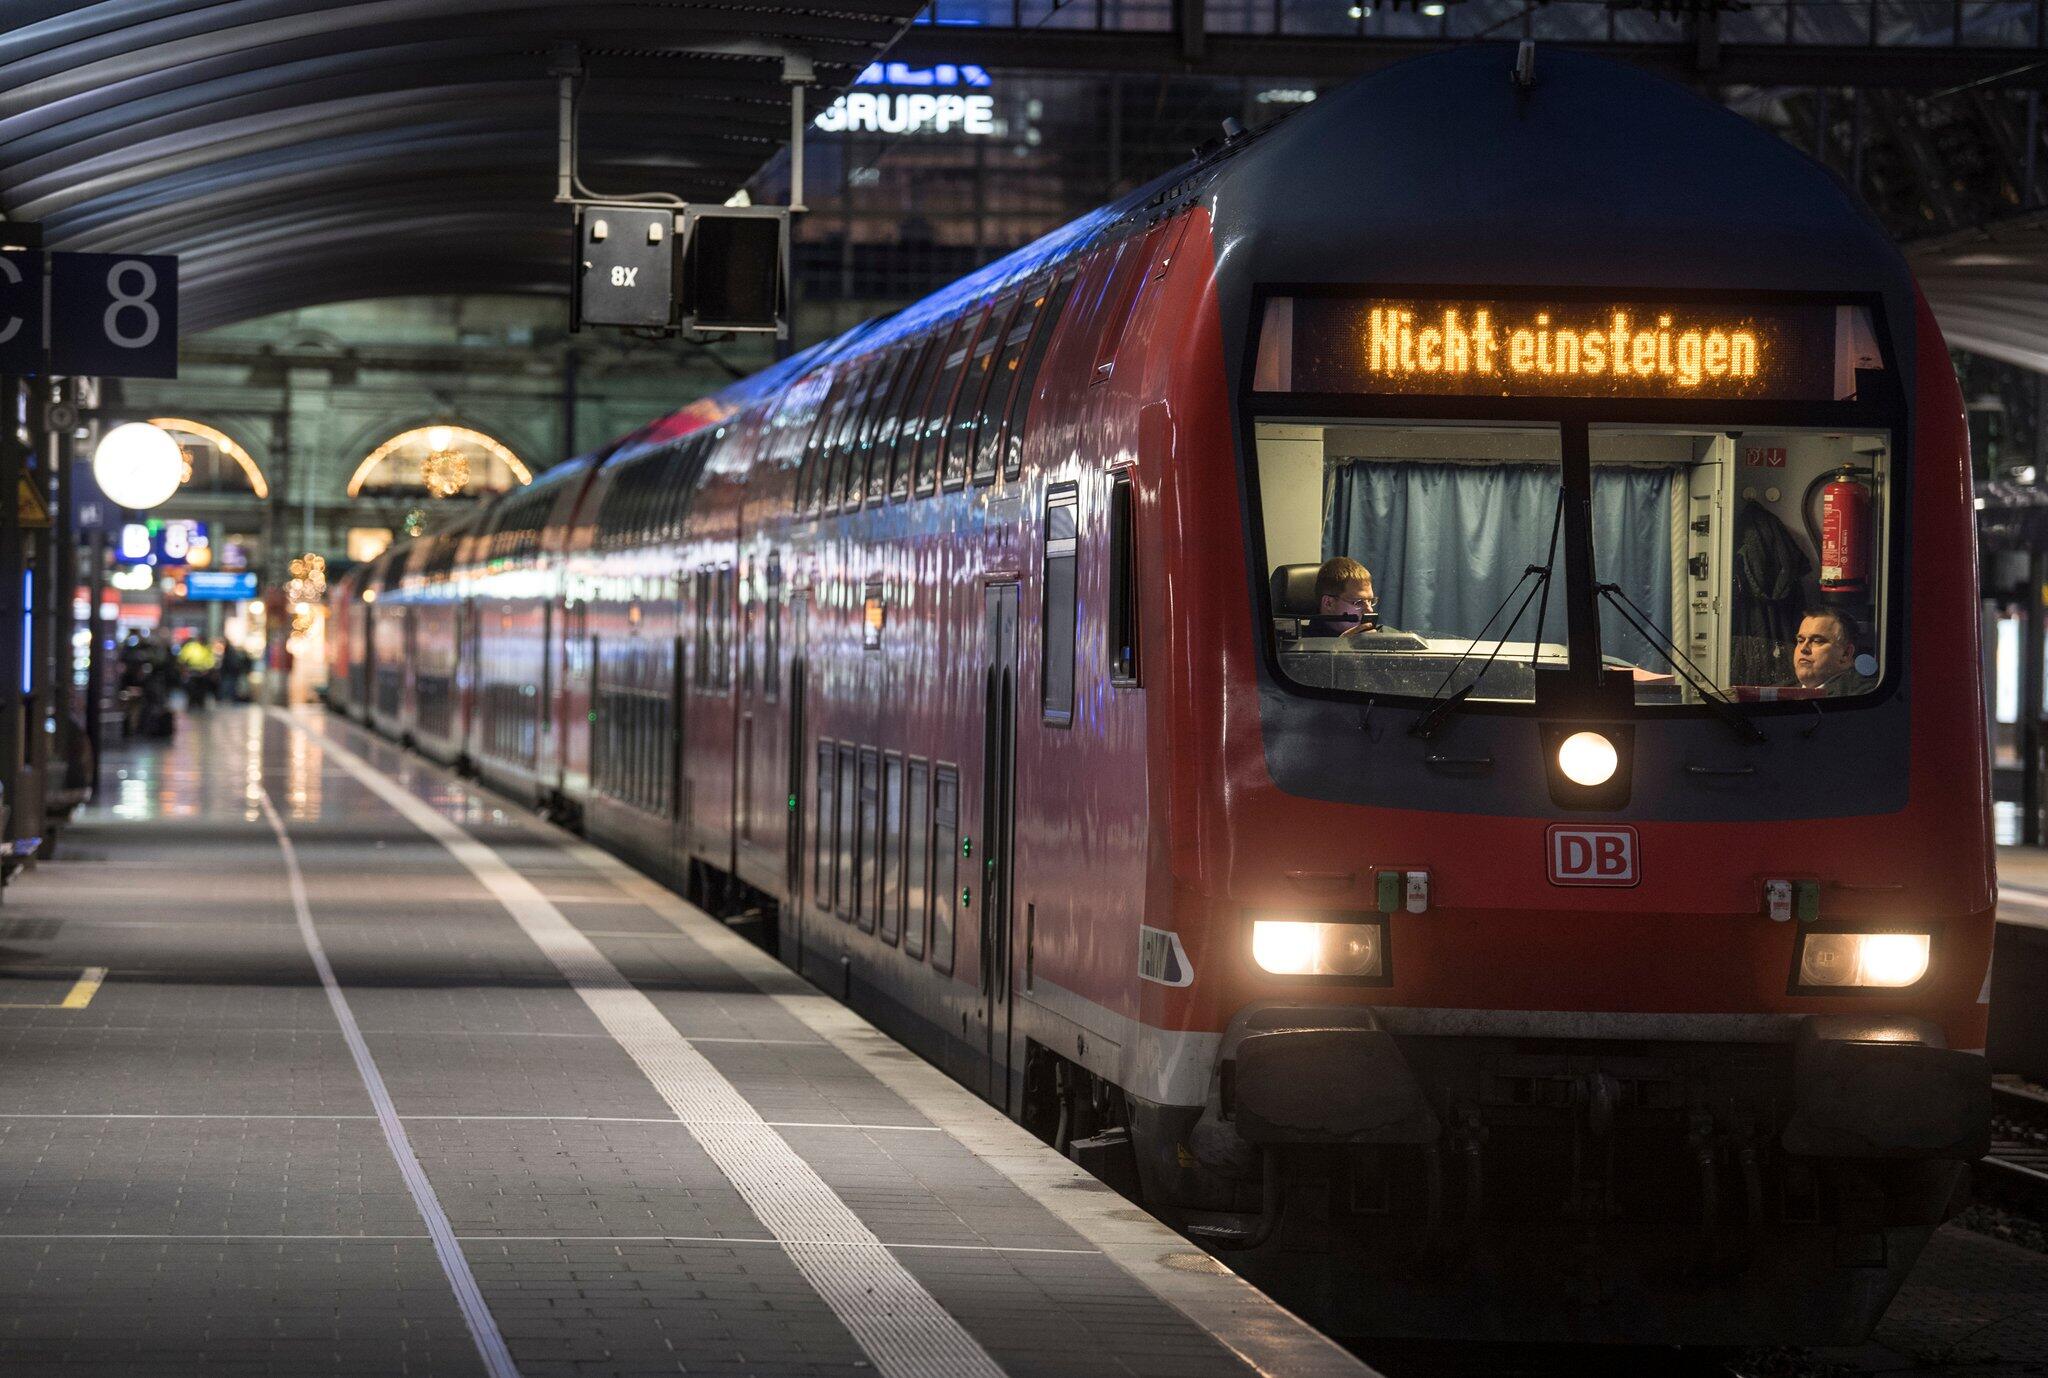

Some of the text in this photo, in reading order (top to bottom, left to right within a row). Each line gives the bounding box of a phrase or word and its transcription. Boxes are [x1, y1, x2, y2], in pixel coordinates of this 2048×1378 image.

[104, 259, 160, 348] 8
[611, 265, 639, 287] 8X
[1369, 308, 1758, 386] Nicht einsteigen
[1560, 835, 1628, 875] DB
